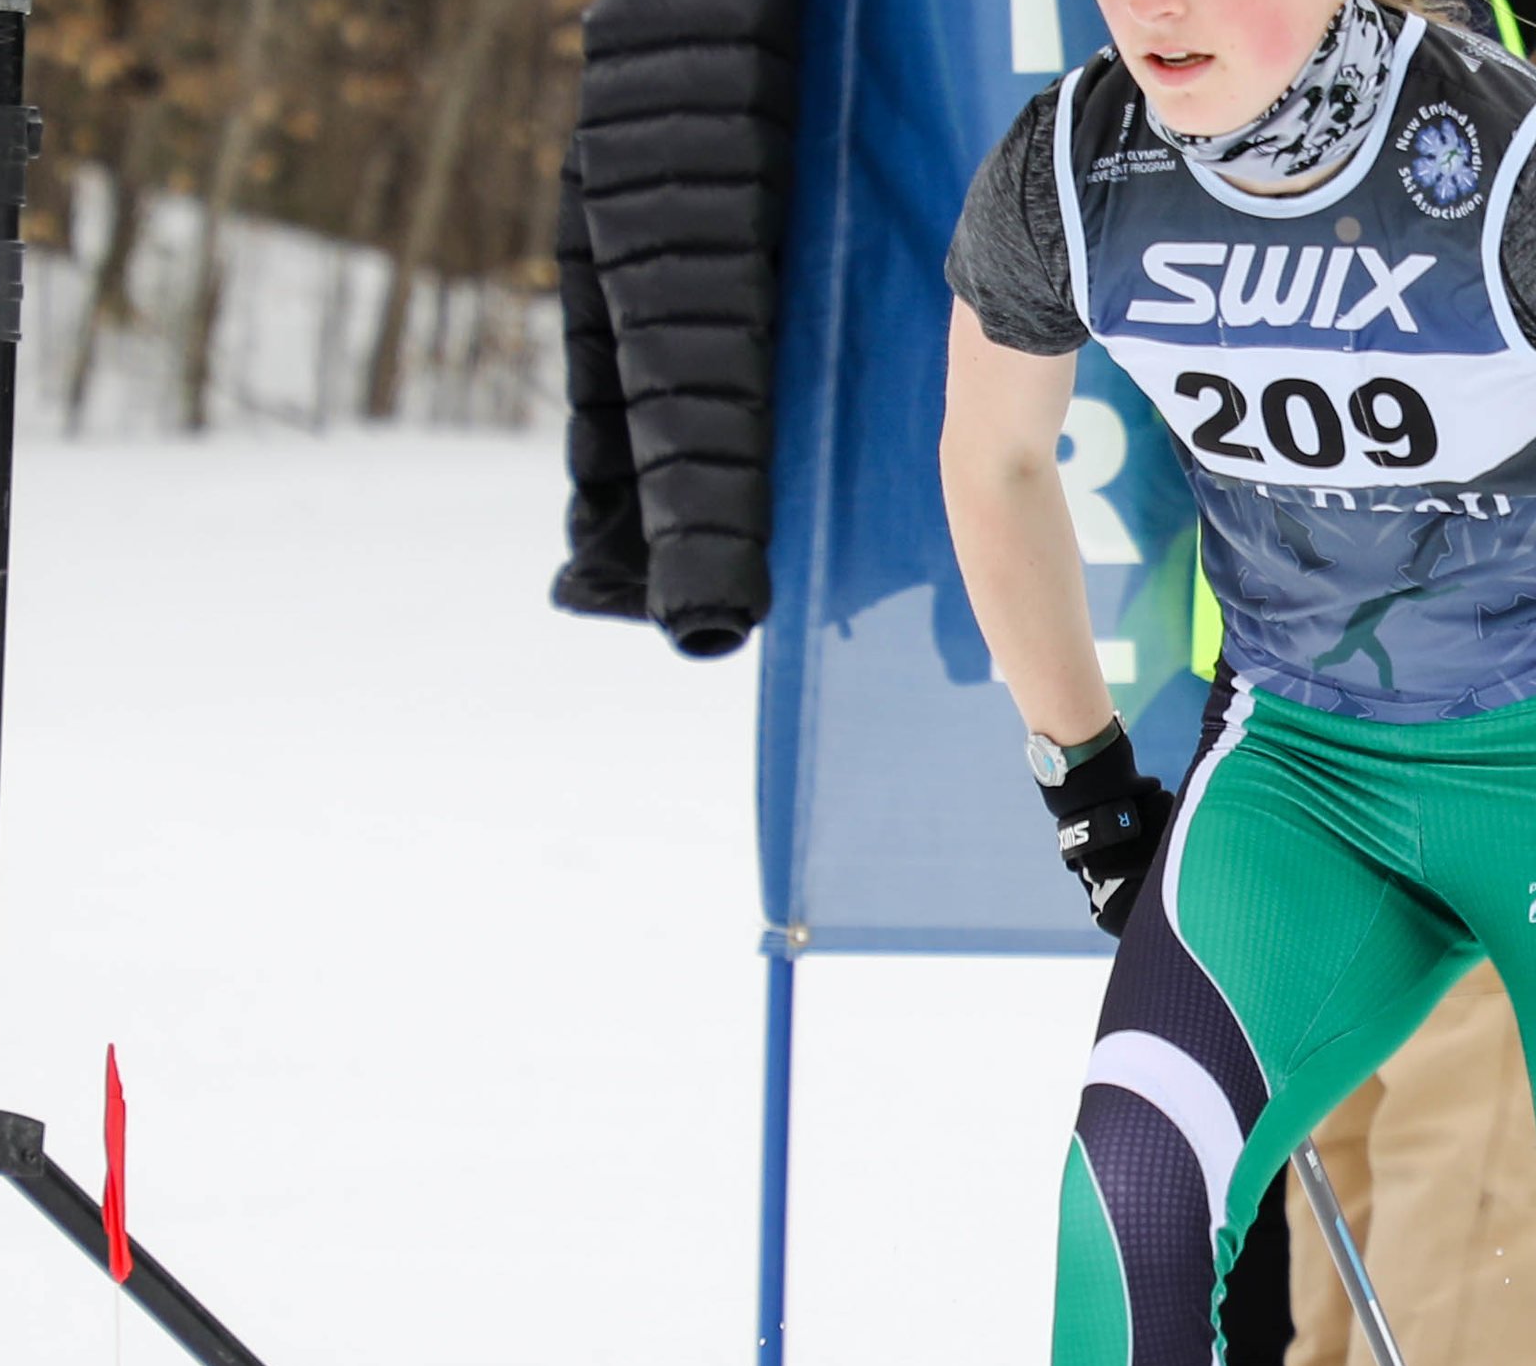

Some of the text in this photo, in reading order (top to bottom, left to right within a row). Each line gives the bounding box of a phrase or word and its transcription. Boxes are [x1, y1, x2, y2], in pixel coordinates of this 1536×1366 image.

[1395, 117, 1421, 151] New
[1398, 166, 1417, 193] Ski
[1125, 241, 1438, 334] SWIX
[1173, 370, 1438, 470] 209
